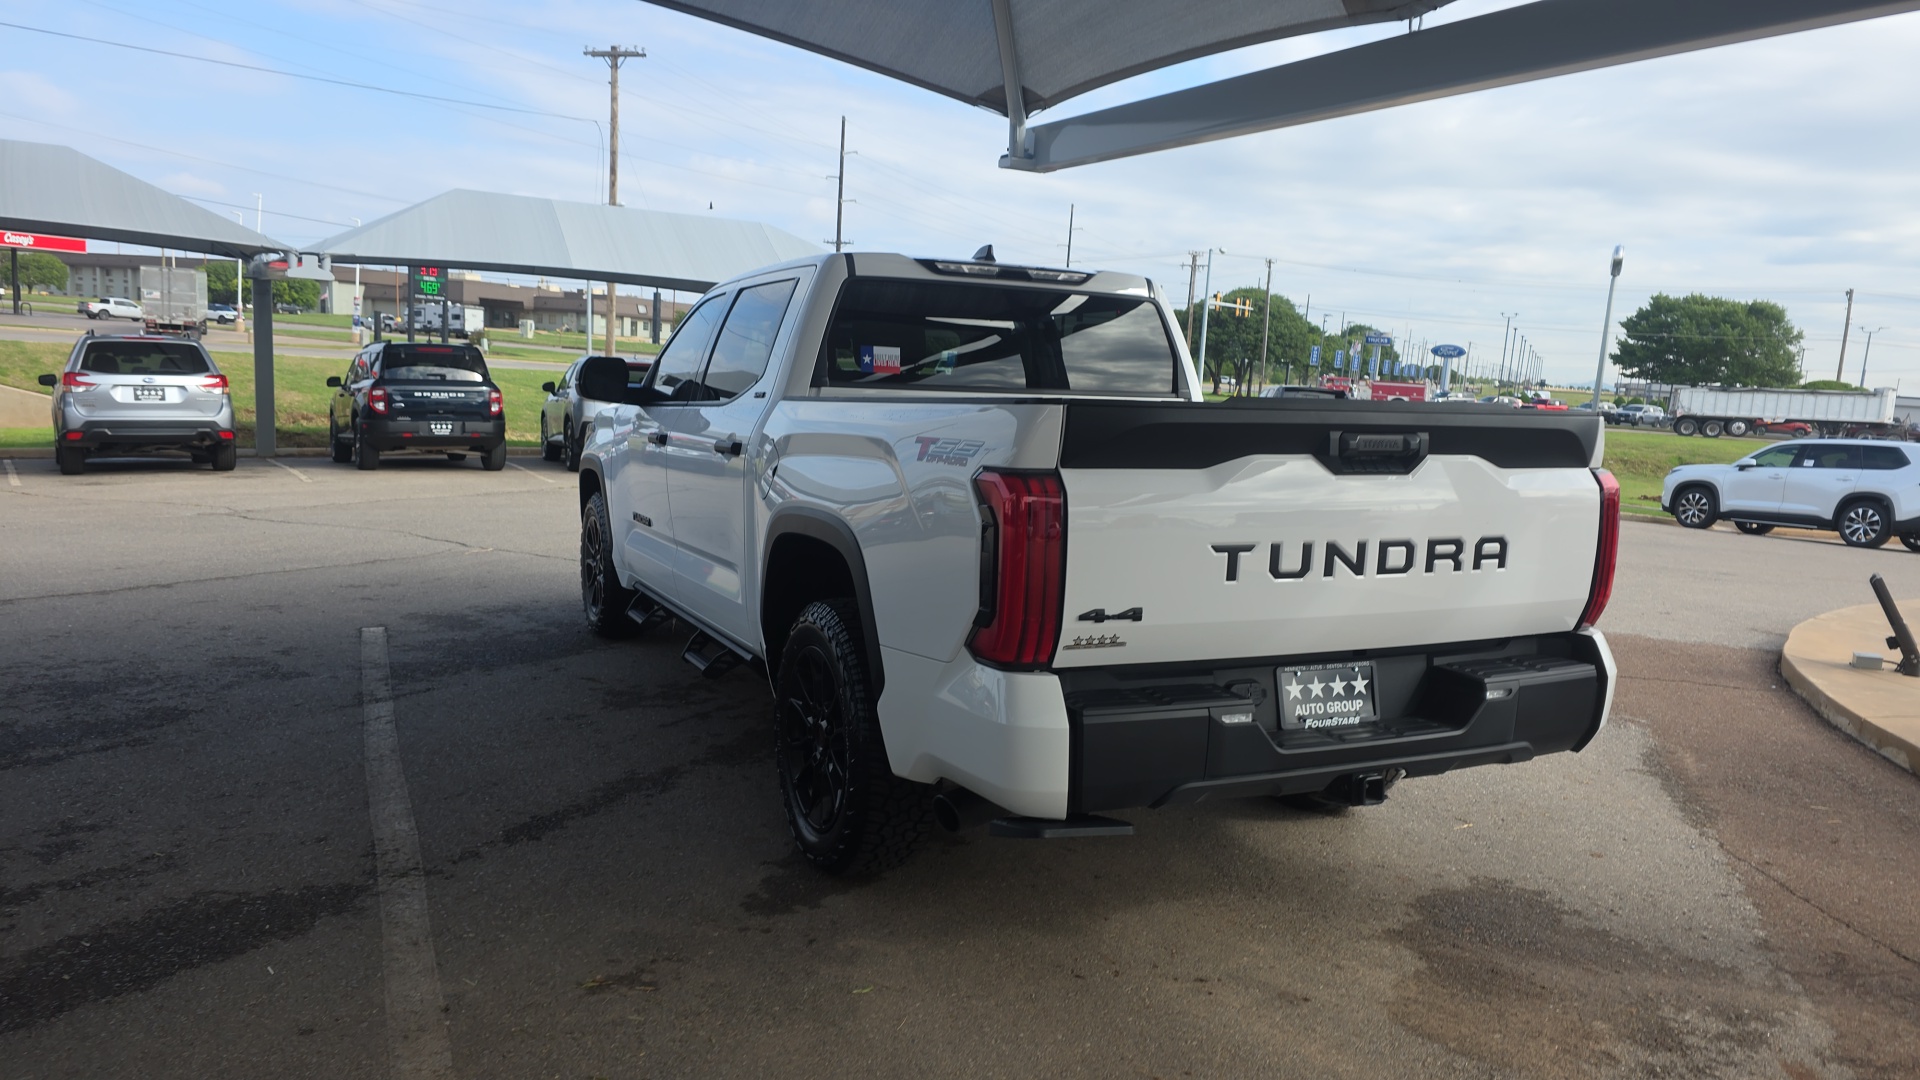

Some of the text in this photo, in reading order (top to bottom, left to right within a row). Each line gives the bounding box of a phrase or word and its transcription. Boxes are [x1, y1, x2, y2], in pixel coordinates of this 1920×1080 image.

[4, 232, 34, 246] Casey's
[1437, 346, 1460, 356] Ford
[1209, 535, 1509, 583] TUNDRA
[1294, 699, 1364, 717] AUTO GROUP
